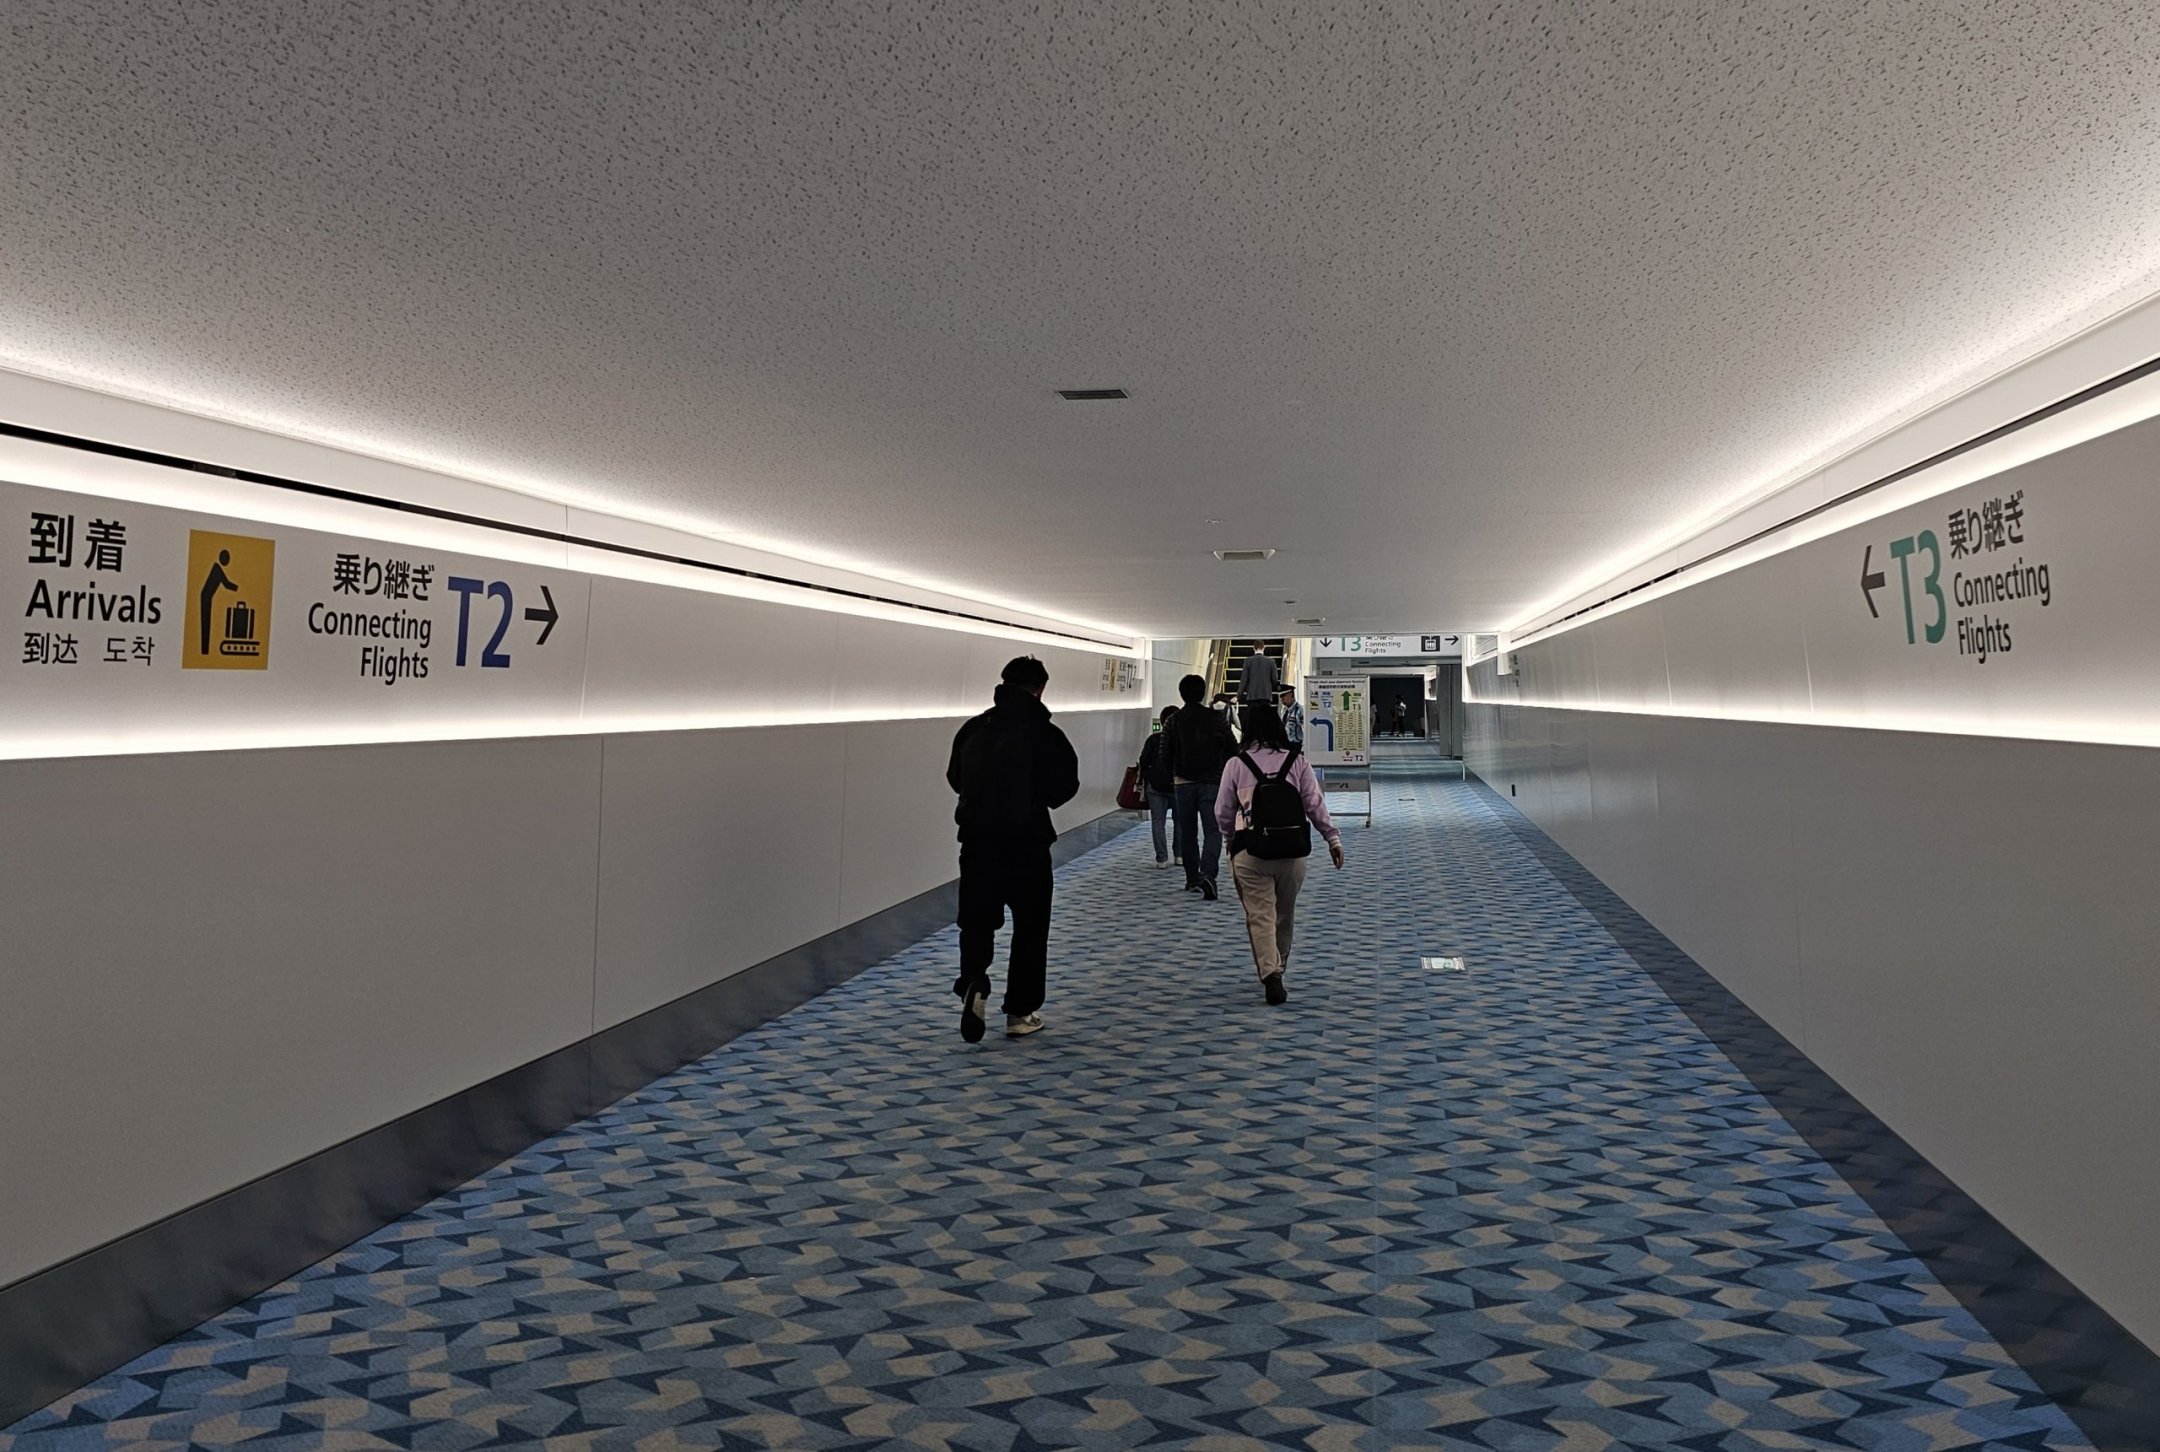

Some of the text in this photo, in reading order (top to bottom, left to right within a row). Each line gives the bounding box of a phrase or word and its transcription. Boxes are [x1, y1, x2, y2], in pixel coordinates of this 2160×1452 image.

[28, 512, 127, 572] 到着
[1948, 489, 2024, 560] 乗り継ぎ
[25, 579, 162, 625] Arrivals
[333, 553, 435, 602] 乗り継ぎ
[1890, 529, 1947, 645] T3
[1953, 557, 2050, 607] Connecting
[308, 602, 432, 648] Connecting
[447, 576, 514, 669] T2
[1341, 637, 1360, 651] T3
[1957, 614, 2012, 664] Flights
[22, 632, 79, 665] 到达
[103, 635, 156, 667] 도착
[360, 645, 429, 686] Flights
